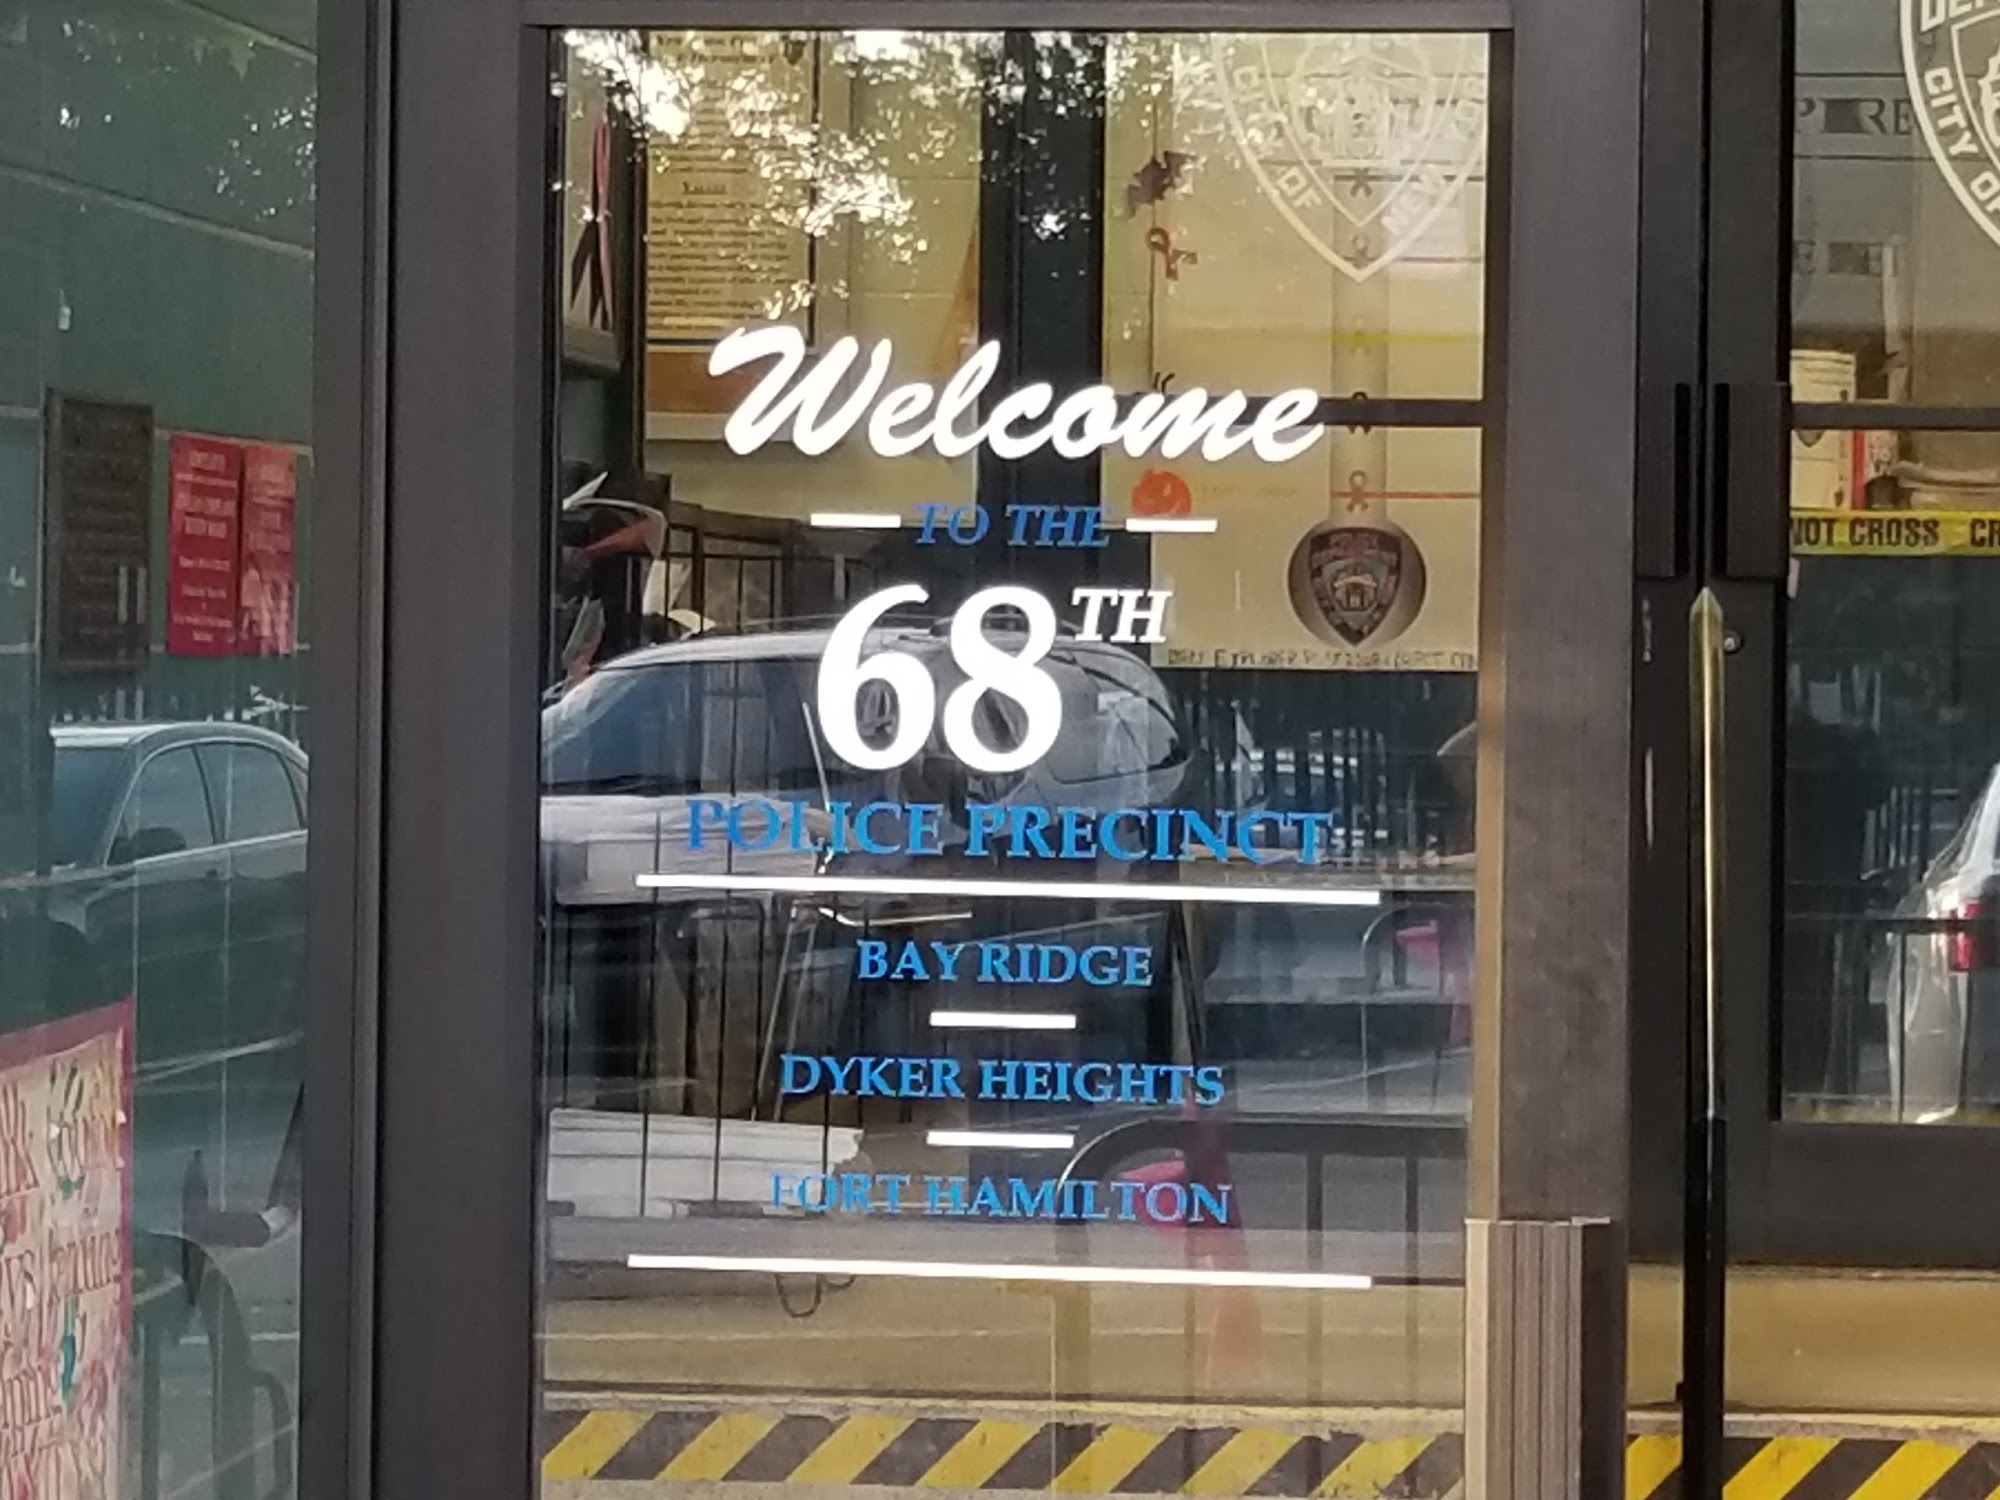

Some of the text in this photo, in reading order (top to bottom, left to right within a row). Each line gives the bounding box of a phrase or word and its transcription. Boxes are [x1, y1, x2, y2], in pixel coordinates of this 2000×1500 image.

[1924, 66, 1979, 156] CITY
[709, 325, 1324, 461] Welcome
[916, 503, 1111, 548] TO THE
[1848, 517, 1941, 548] CROSS
[1072, 587, 1173, 644] TH
[686, 797, 1335, 866] POLICE PRECINCT
[857, 939, 1155, 987] BAY RIDGE
[780, 1052, 1226, 1106] DYKER HEIGHTS
[771, 1172, 1231, 1225] FORT HAMILTON
